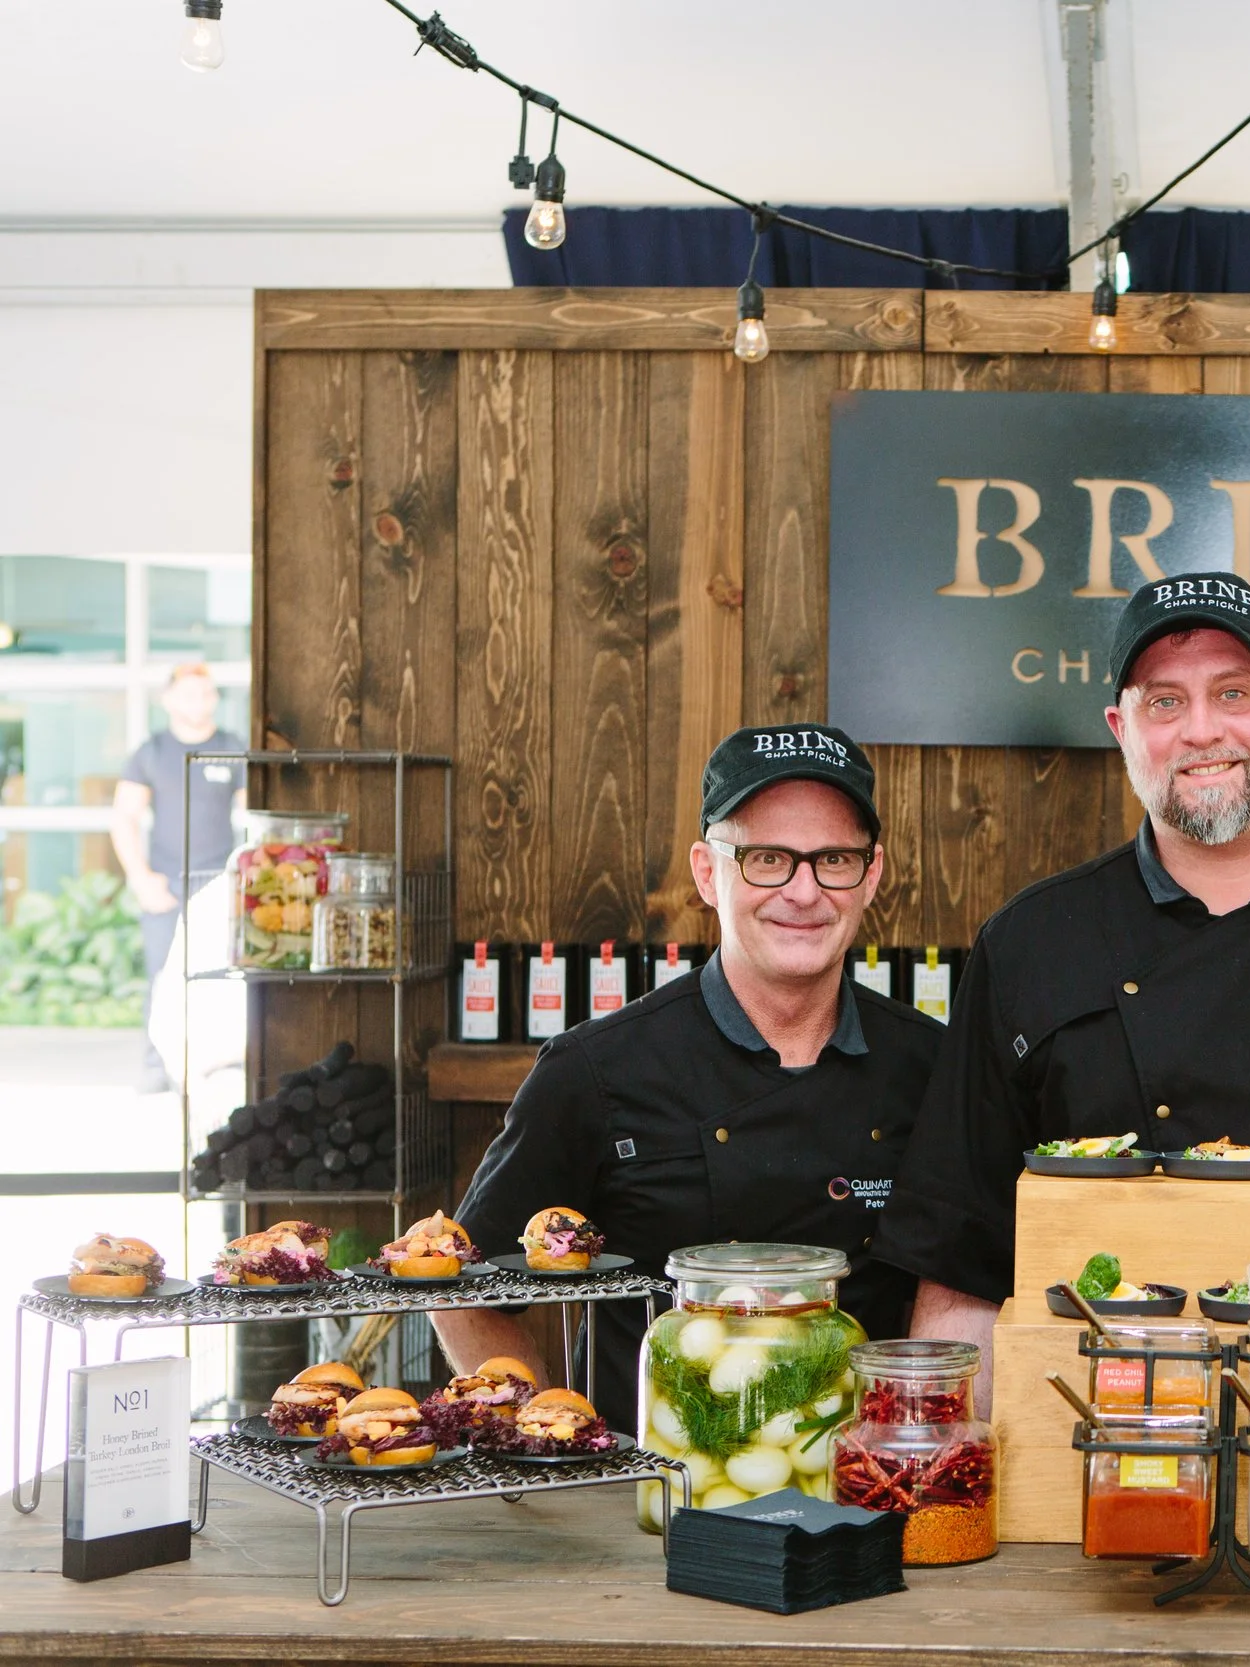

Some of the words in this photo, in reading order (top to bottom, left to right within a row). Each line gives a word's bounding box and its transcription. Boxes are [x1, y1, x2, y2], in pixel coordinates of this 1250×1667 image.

[1011, 647, 1113, 685] CH
[1103, 1368, 1121, 1377] RED
[1124, 1368, 1145, 1377] CHIL
[1107, 1378, 1143, 1387] PEANUT
[102, 1434, 130, 1446] Honey
[131, 1427, 158, 1441] Brined
[119, 1443, 149, 1457] London
[151, 1439, 171, 1452] Broil
